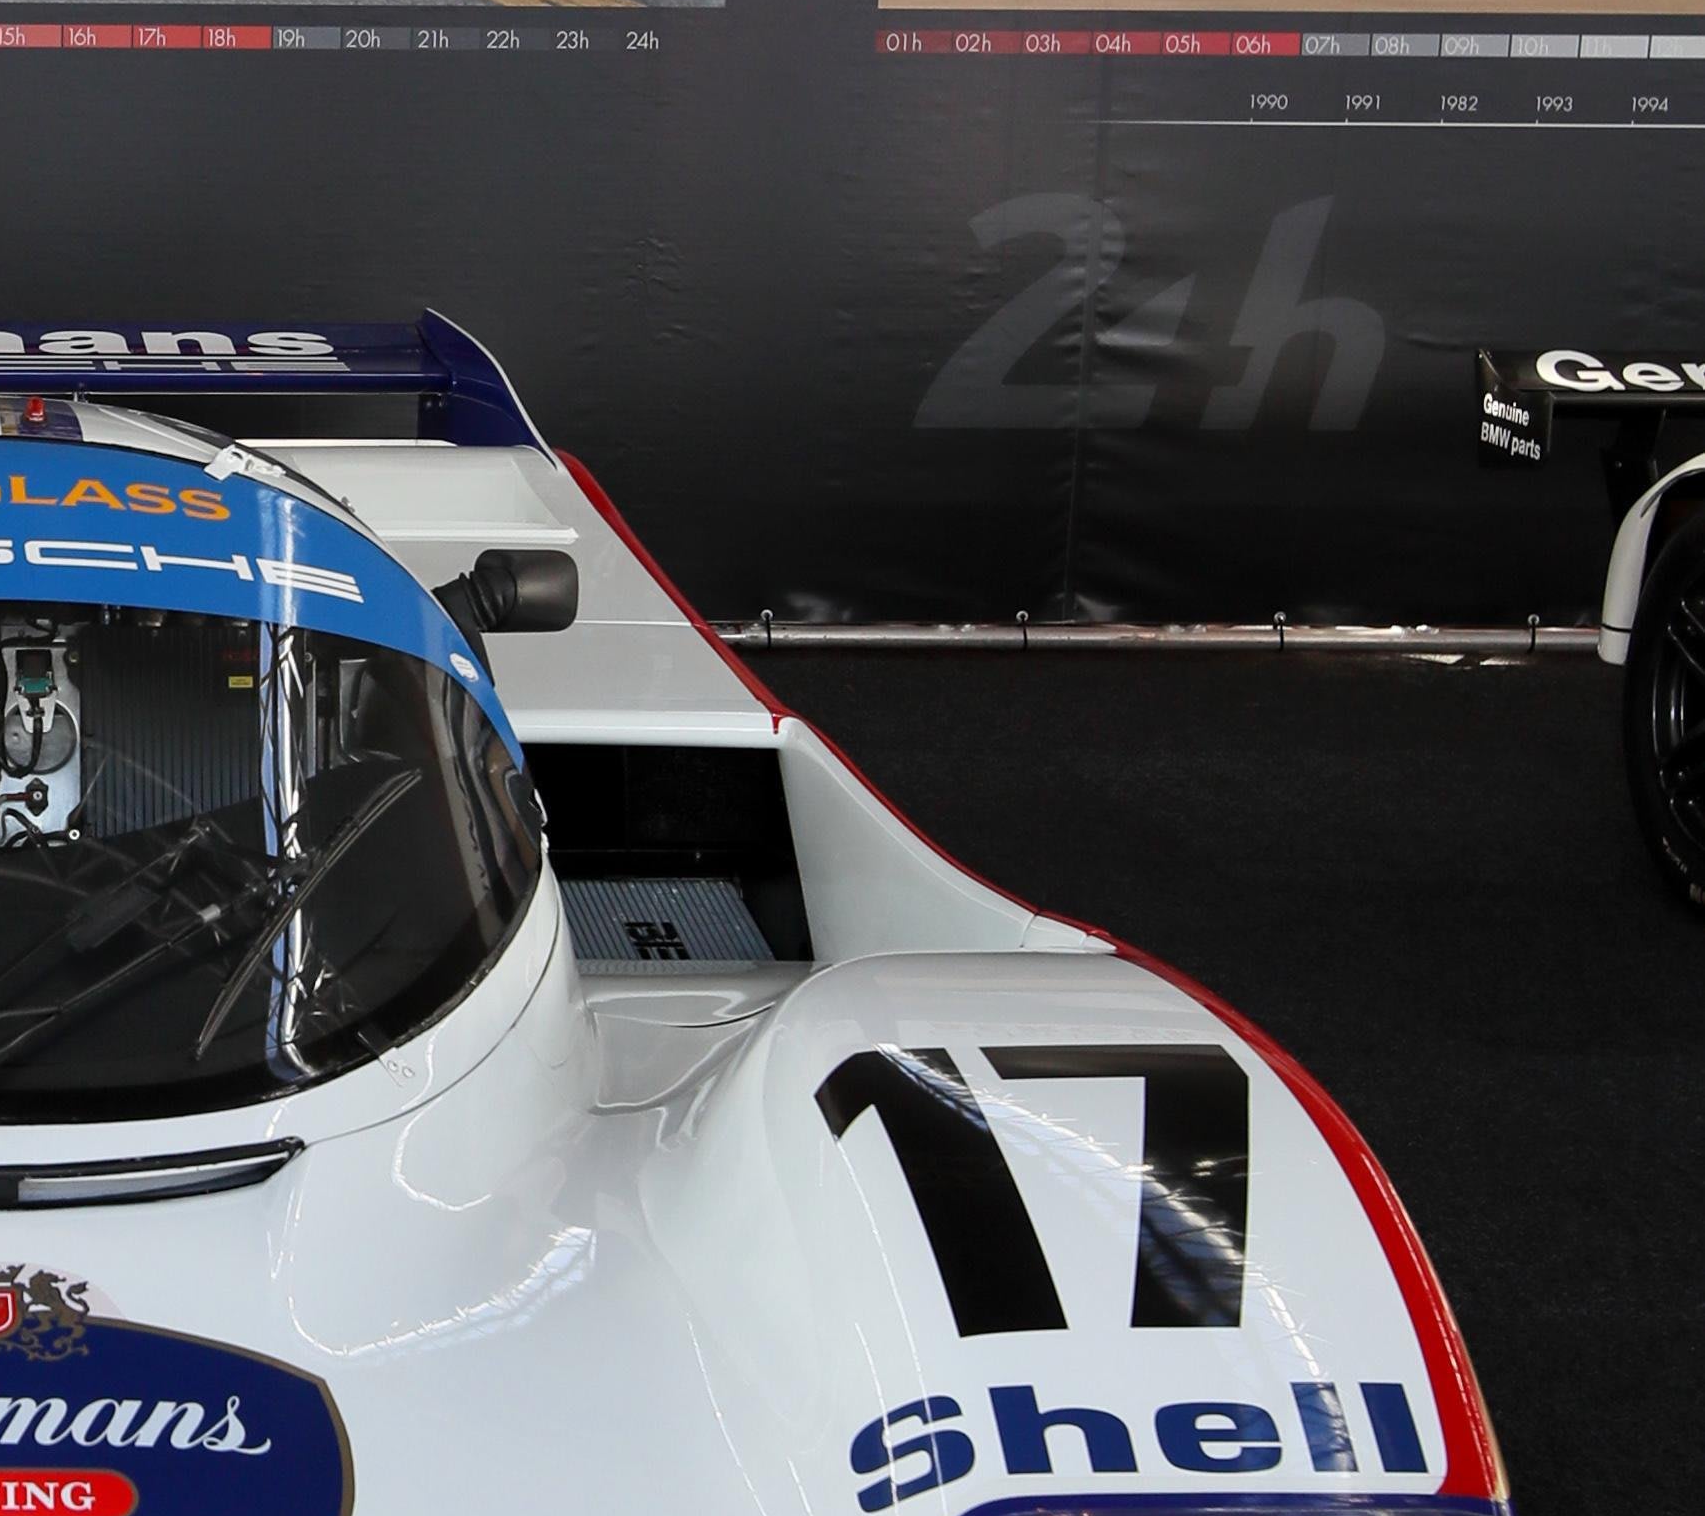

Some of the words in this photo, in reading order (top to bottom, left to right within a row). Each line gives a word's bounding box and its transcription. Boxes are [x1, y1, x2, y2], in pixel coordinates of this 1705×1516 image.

[0, 26, 26, 46] 15h
[69, 26, 96, 46] 16h
[139, 27, 166, 46] 17h
[209, 27, 236, 47] 18h
[278, 28, 305, 48] 19h
[346, 28, 381, 48] 20h
[418, 29, 449, 49] 21h
[486, 29, 520, 49] 22h
[556, 30, 589, 50] 23h
[626, 30, 659, 50] 24h
[886, 32, 922, 52] 01h
[955, 32, 992, 53] 02h
[1025, 33, 1061, 53] 03h
[1095, 33, 1131, 53] 04h
[1165, 33, 1201, 54] 05h
[1236, 34, 1271, 54] 06h
[1304, 35, 1341, 55] 07h
[1374, 35, 1411, 56] 08h
[1444, 36, 1480, 56] 09h
[1517, 36, 1550, 56] 10h
[1251, 94, 1289, 110] 1990
[1346, 94, 1380, 110] 1991
[1441, 95, 1478, 111] 1982
[1537, 96, 1573, 112] 1993
[1632, 96, 1668, 112] 1994
[1482, 392, 1531, 427] Genuine
[1480, 421, 1511, 450] BMW
[1509, 436, 1542, 461] parts
[813, 1043, 1250, 1338] 17
[849, 1381, 1430, 1514] Shell
